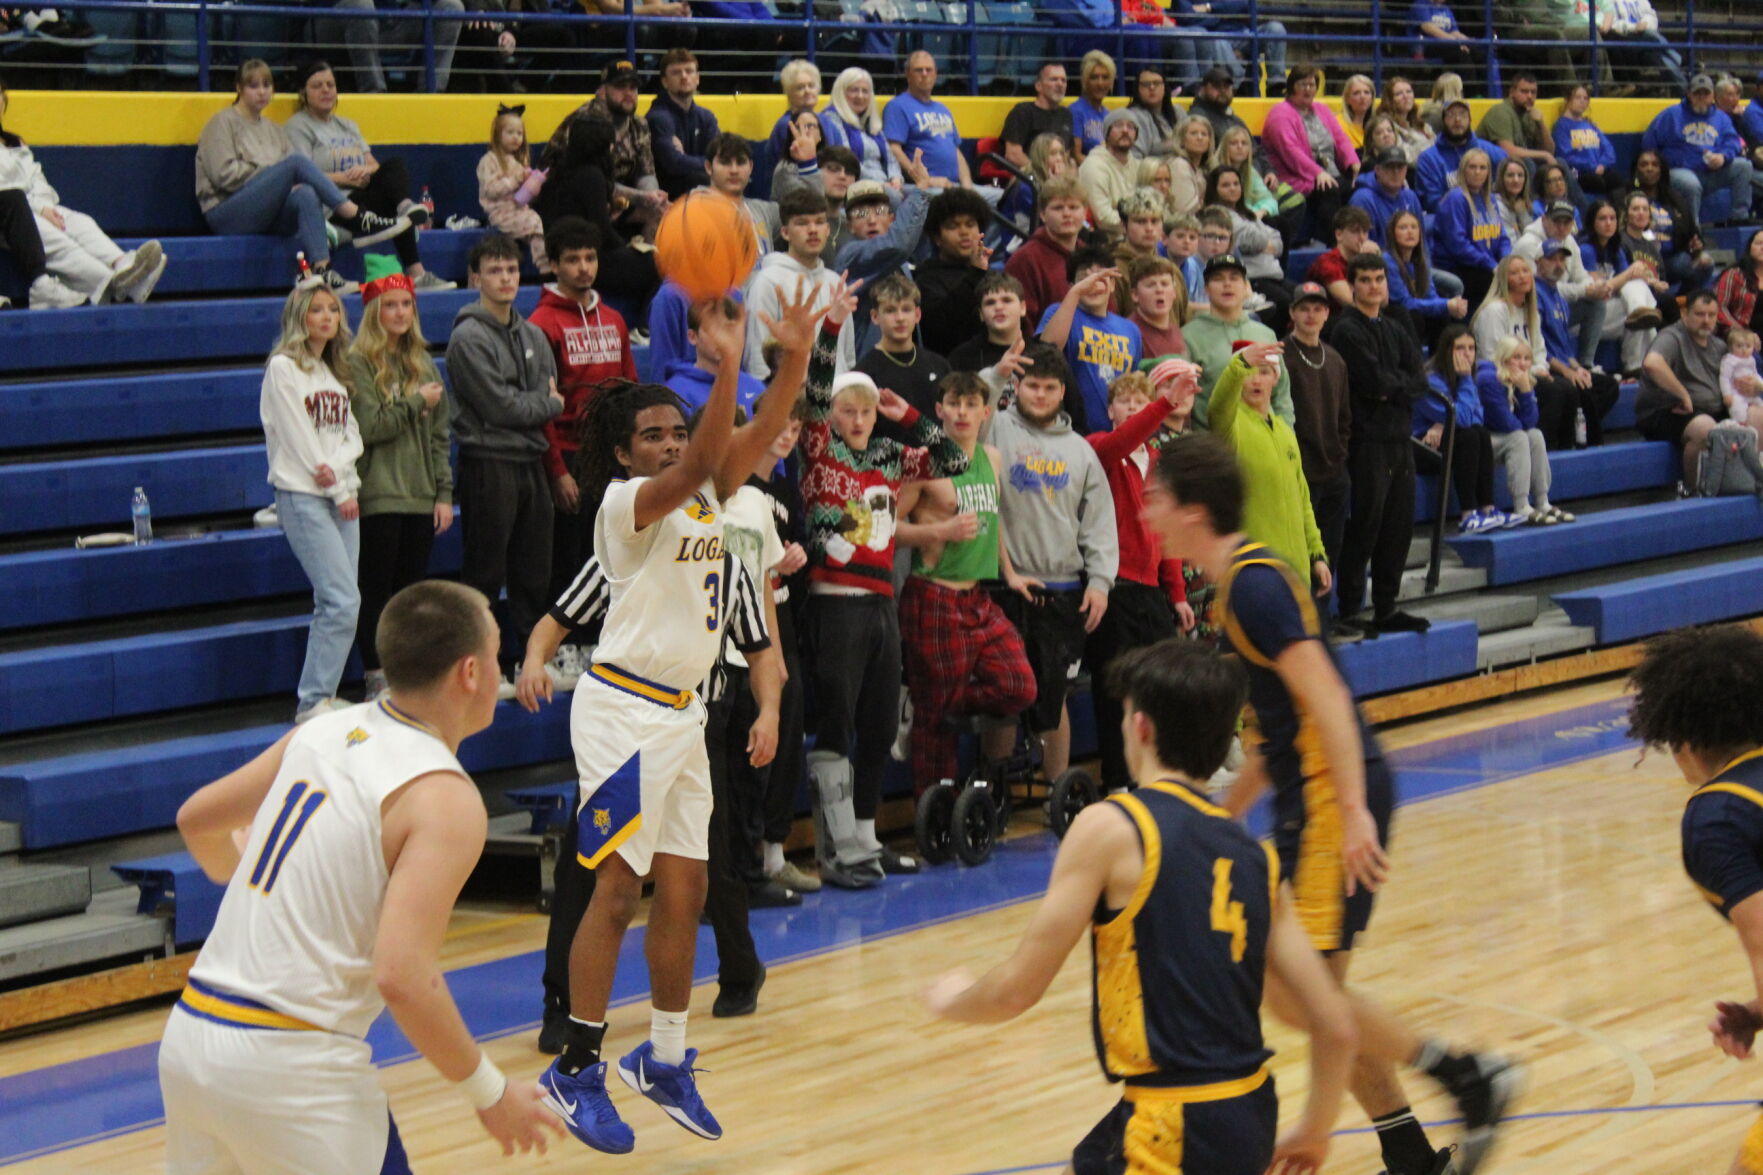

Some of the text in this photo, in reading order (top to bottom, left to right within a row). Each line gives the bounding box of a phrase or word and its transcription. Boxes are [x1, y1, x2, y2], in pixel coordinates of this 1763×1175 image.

[1082, 325, 1130, 353] EXIT
[1026, 455, 1067, 477] LOGAN
[704, 571, 720, 632] 3
[247, 779, 328, 896] 11
[1209, 857, 1248, 964] 4
